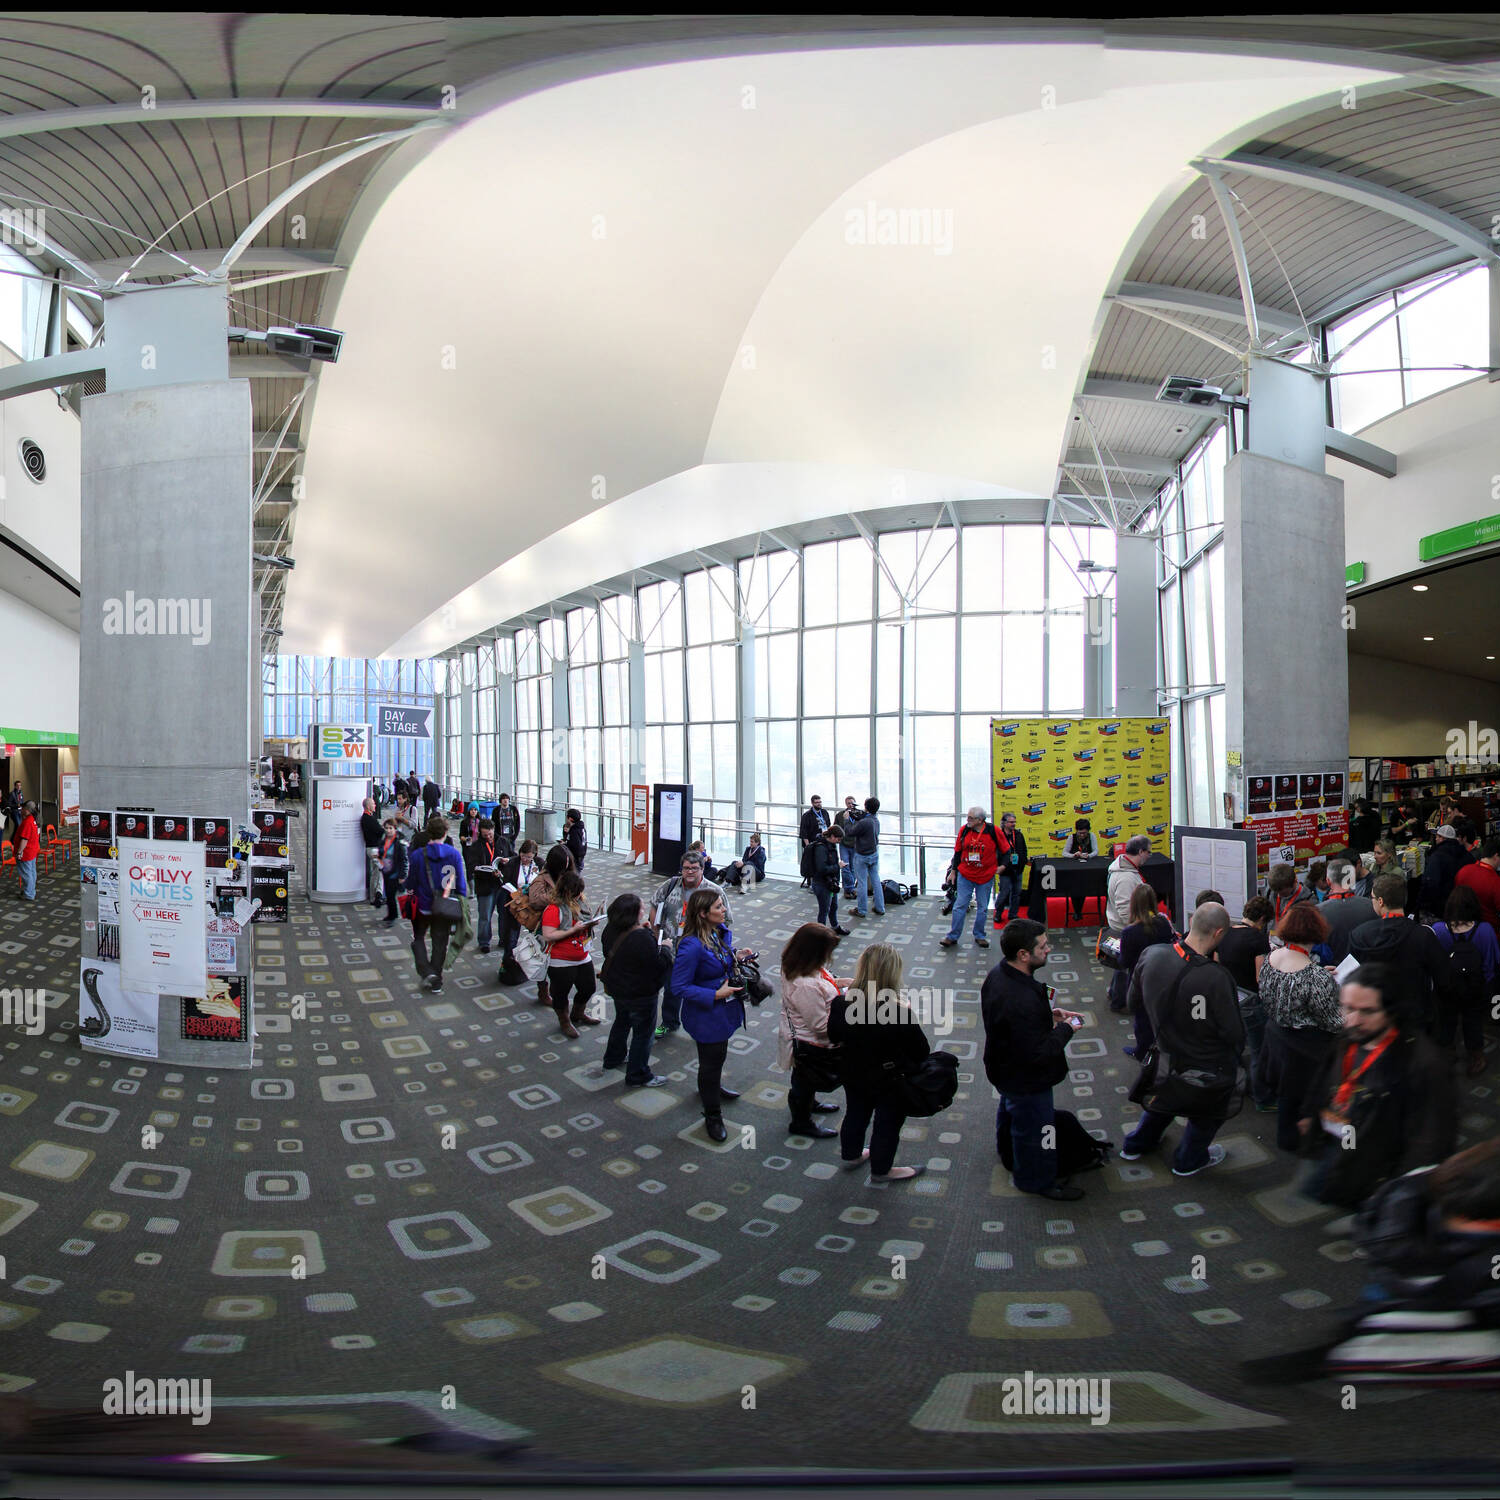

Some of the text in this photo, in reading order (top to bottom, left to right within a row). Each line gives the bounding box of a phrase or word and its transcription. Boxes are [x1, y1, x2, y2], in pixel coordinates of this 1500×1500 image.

[384, 710, 406, 721] DAY
[384, 721, 418, 734] STAGE
[134, 851, 147, 860] GET
[129, 866, 193, 884] OGILVY
[130, 881, 193, 901] NOTES
[143, 909, 181, 921] IN HERE
